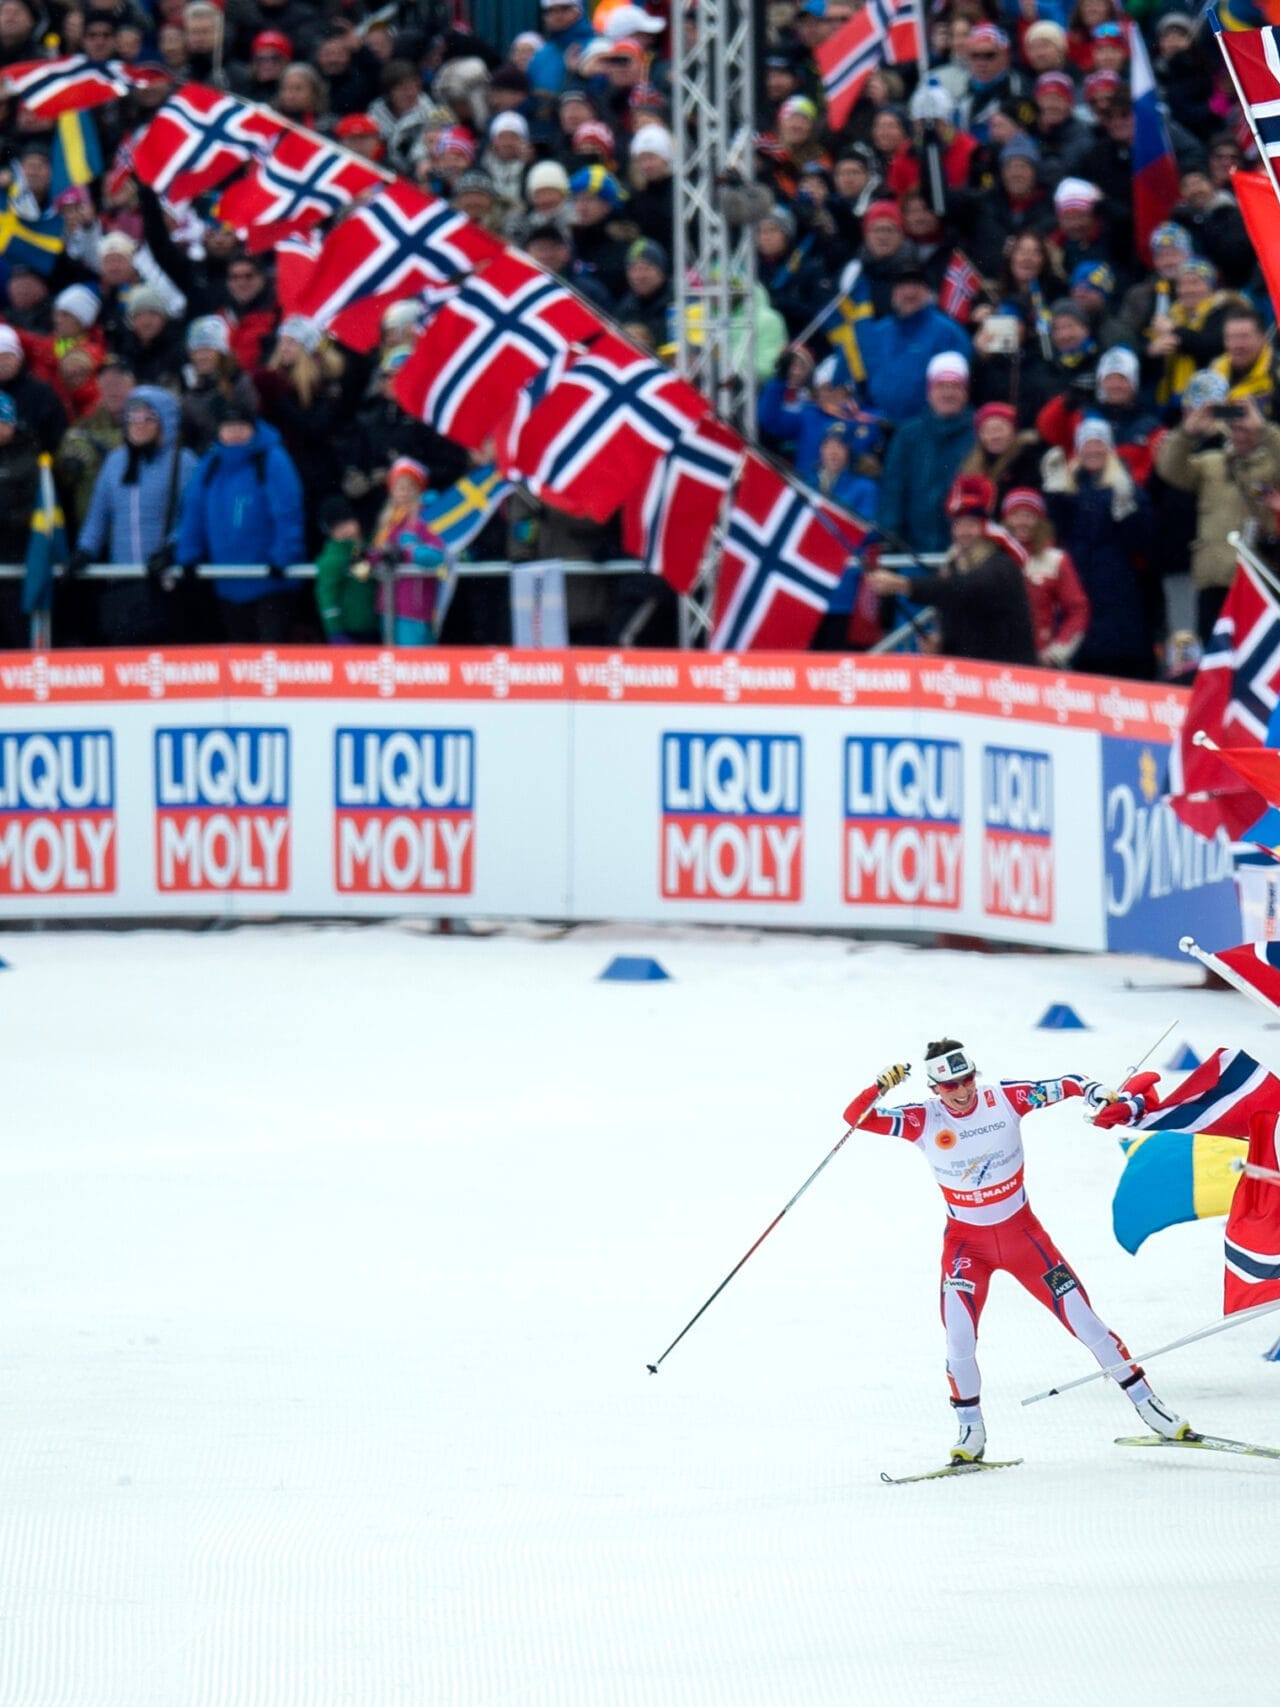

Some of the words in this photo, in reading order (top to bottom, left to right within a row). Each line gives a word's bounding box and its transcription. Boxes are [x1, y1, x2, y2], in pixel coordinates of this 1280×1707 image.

[159, 730, 287, 809] LIQUI
[339, 732, 471, 810] LIQUI
[665, 737, 799, 814] LIQUI
[848, 739, 960, 819] LIQUI
[986, 749, 1051, 832] LIQUI
[160, 814, 289, 888] MOLY
[340, 815, 472, 889] MOLY
[665, 822, 801, 897] MOLY
[848, 825, 961, 906] MOLY
[985, 836, 1053, 917] MOLY
[1055, 1279, 1076, 1296] AKER
